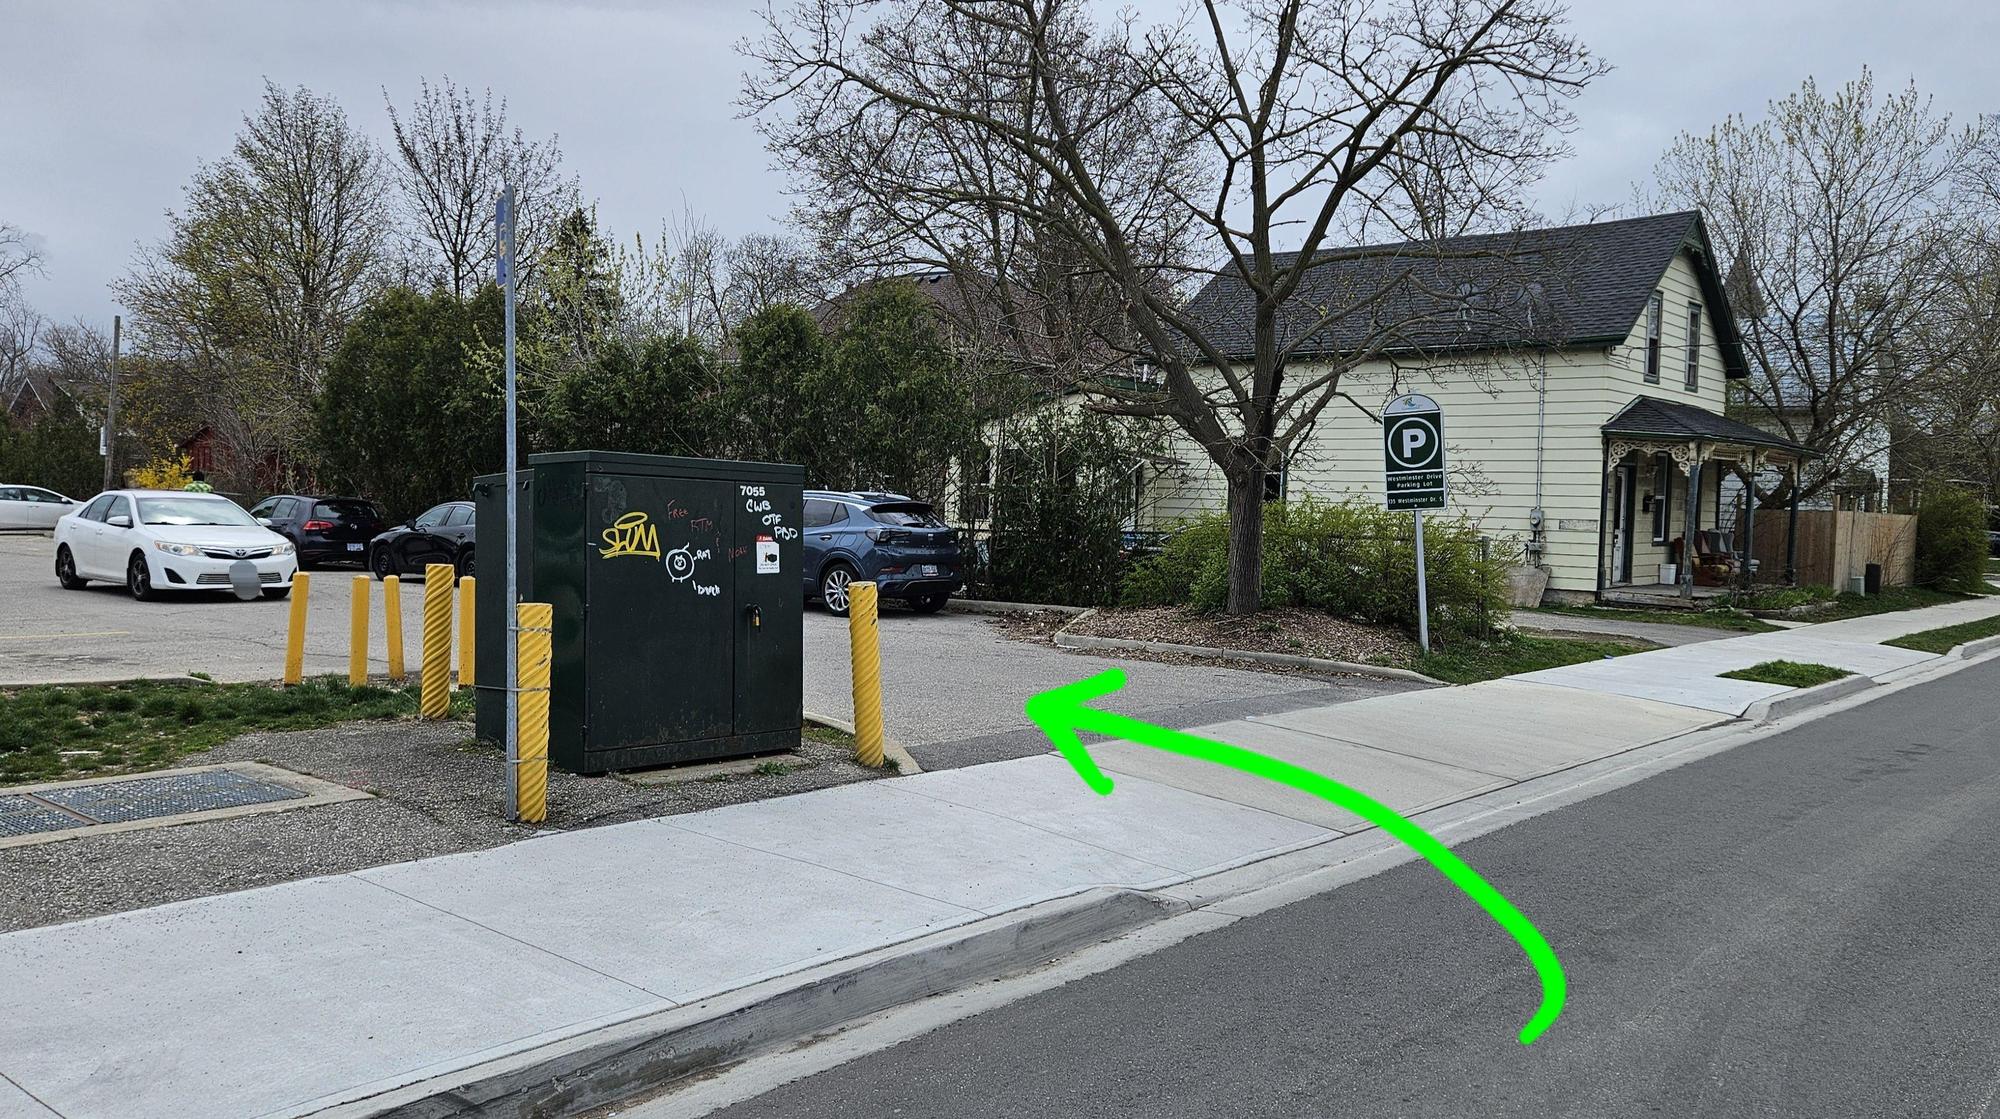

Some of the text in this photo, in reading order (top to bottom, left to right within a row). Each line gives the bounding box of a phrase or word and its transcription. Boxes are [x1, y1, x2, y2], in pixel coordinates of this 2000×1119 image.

[1402, 428, 1426, 458] P
[739, 485, 766, 497] 7055
[746, 498, 771, 512] CWB
[762, 513, 782, 525] OTF
